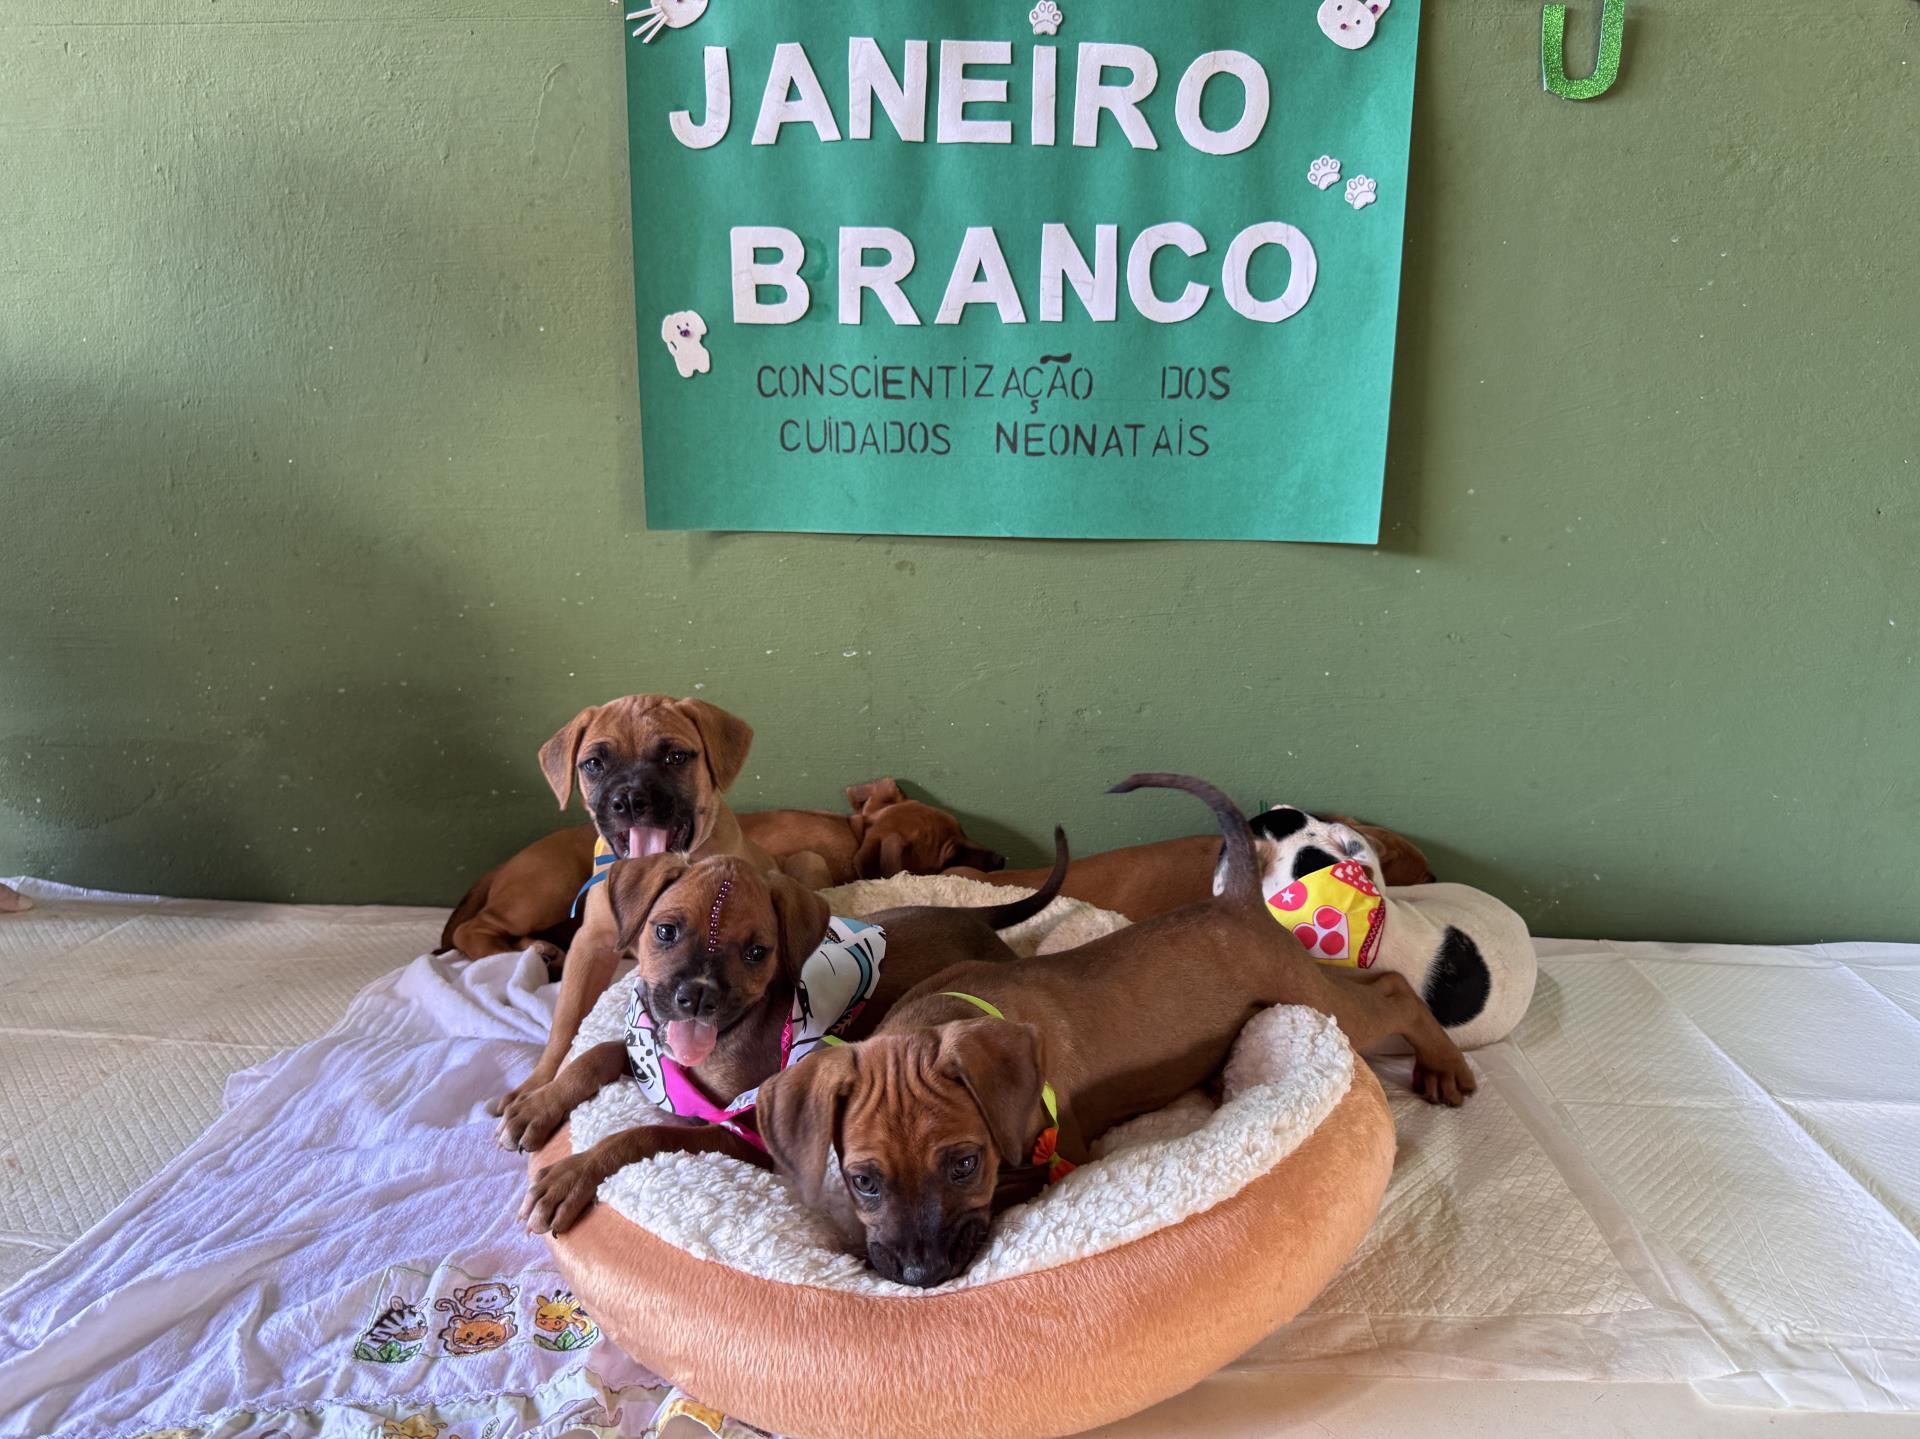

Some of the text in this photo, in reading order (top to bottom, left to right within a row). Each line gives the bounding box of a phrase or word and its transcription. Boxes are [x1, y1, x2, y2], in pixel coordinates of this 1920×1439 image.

[669, 37, 1270, 155] JANEIRO
[729, 222, 1318, 325] BRANCO
[1161, 365, 1231, 400] DOS
[780, 417, 1210, 458] CUIDADOS NEONATAIS
